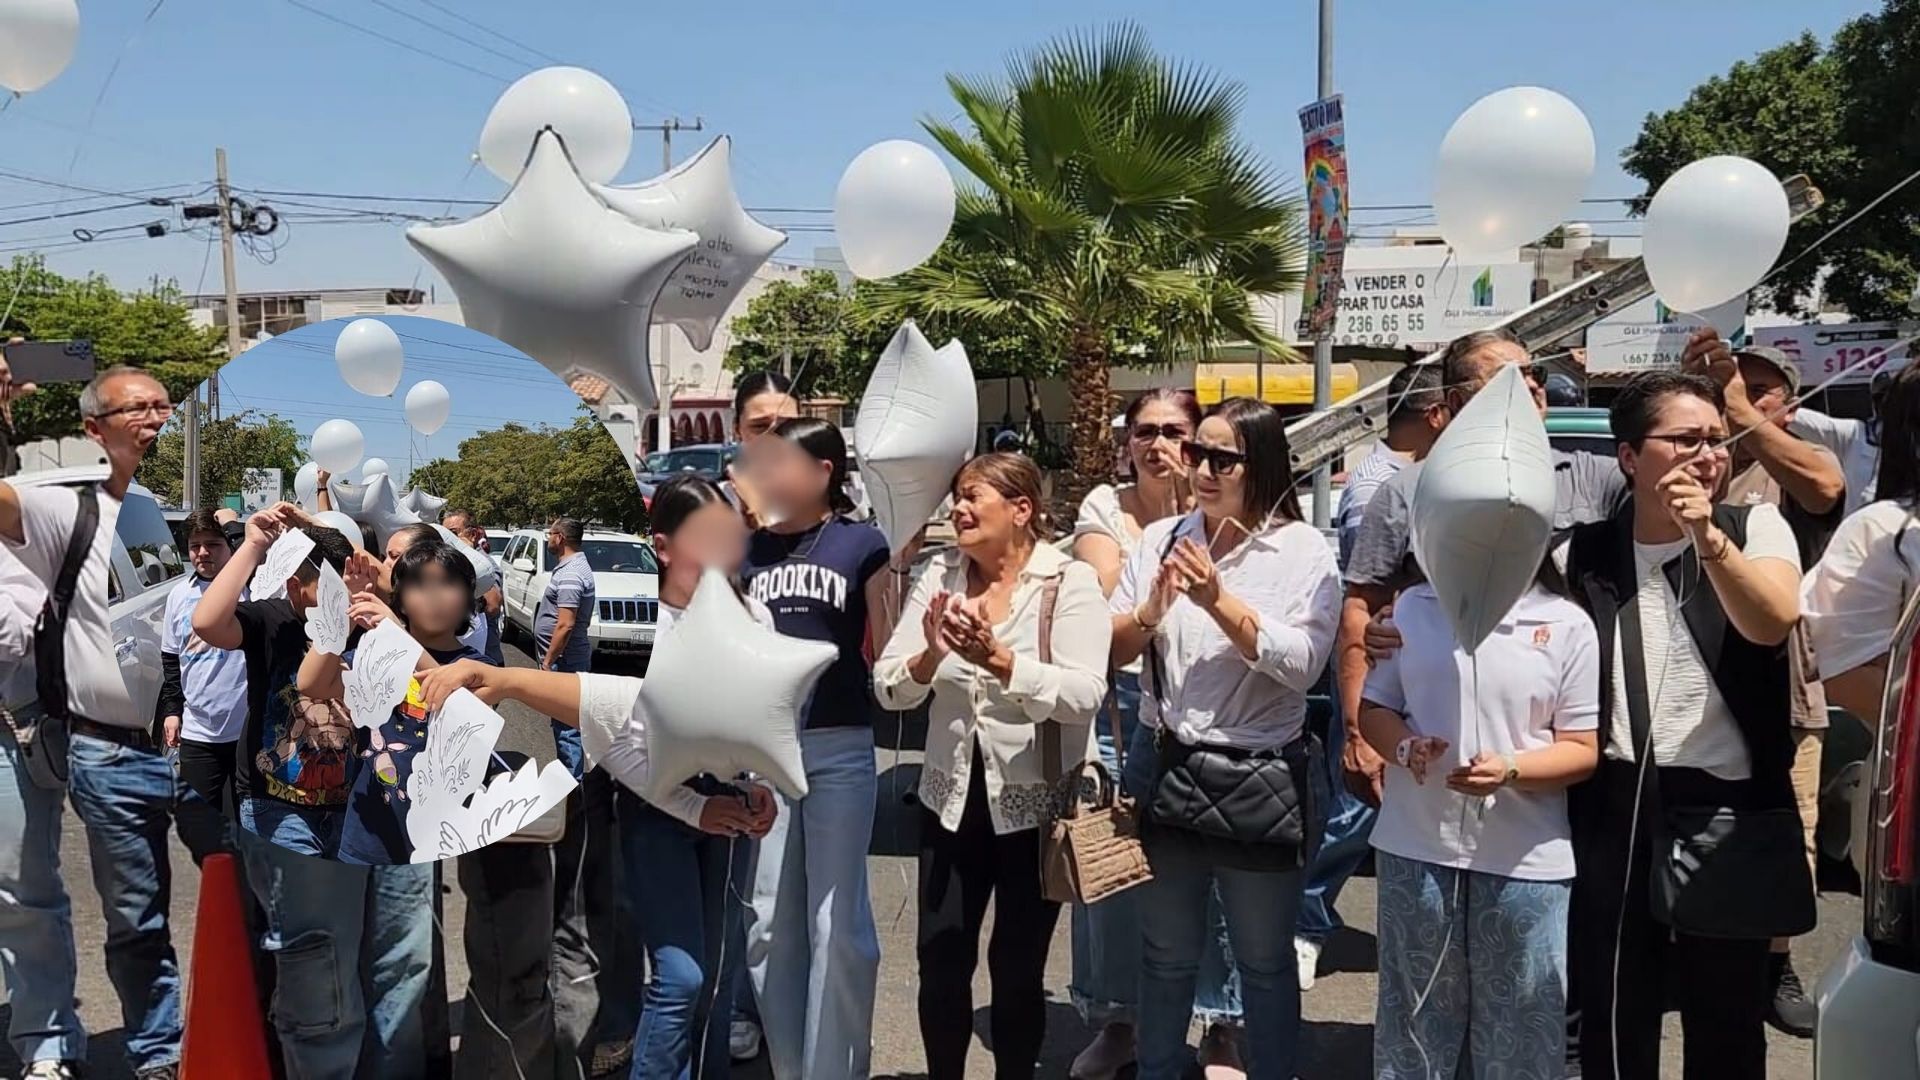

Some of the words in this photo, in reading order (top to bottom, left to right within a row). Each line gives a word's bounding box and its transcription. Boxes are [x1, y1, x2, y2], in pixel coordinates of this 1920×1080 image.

[707, 234, 733, 252] alto
[1354, 275, 1406, 291] VENDER
[1415, 274, 1425, 289] O
[1334, 296, 1369, 311] PRAR
[1372, 295, 1388, 310] TU
[1390, 294, 1424, 309] CASA
[1348, 315, 1373, 333] 236
[1381, 314, 1399, 332] 65
[1407, 313, 1424, 331] 55
[1652, 352, 1671, 363] 236
